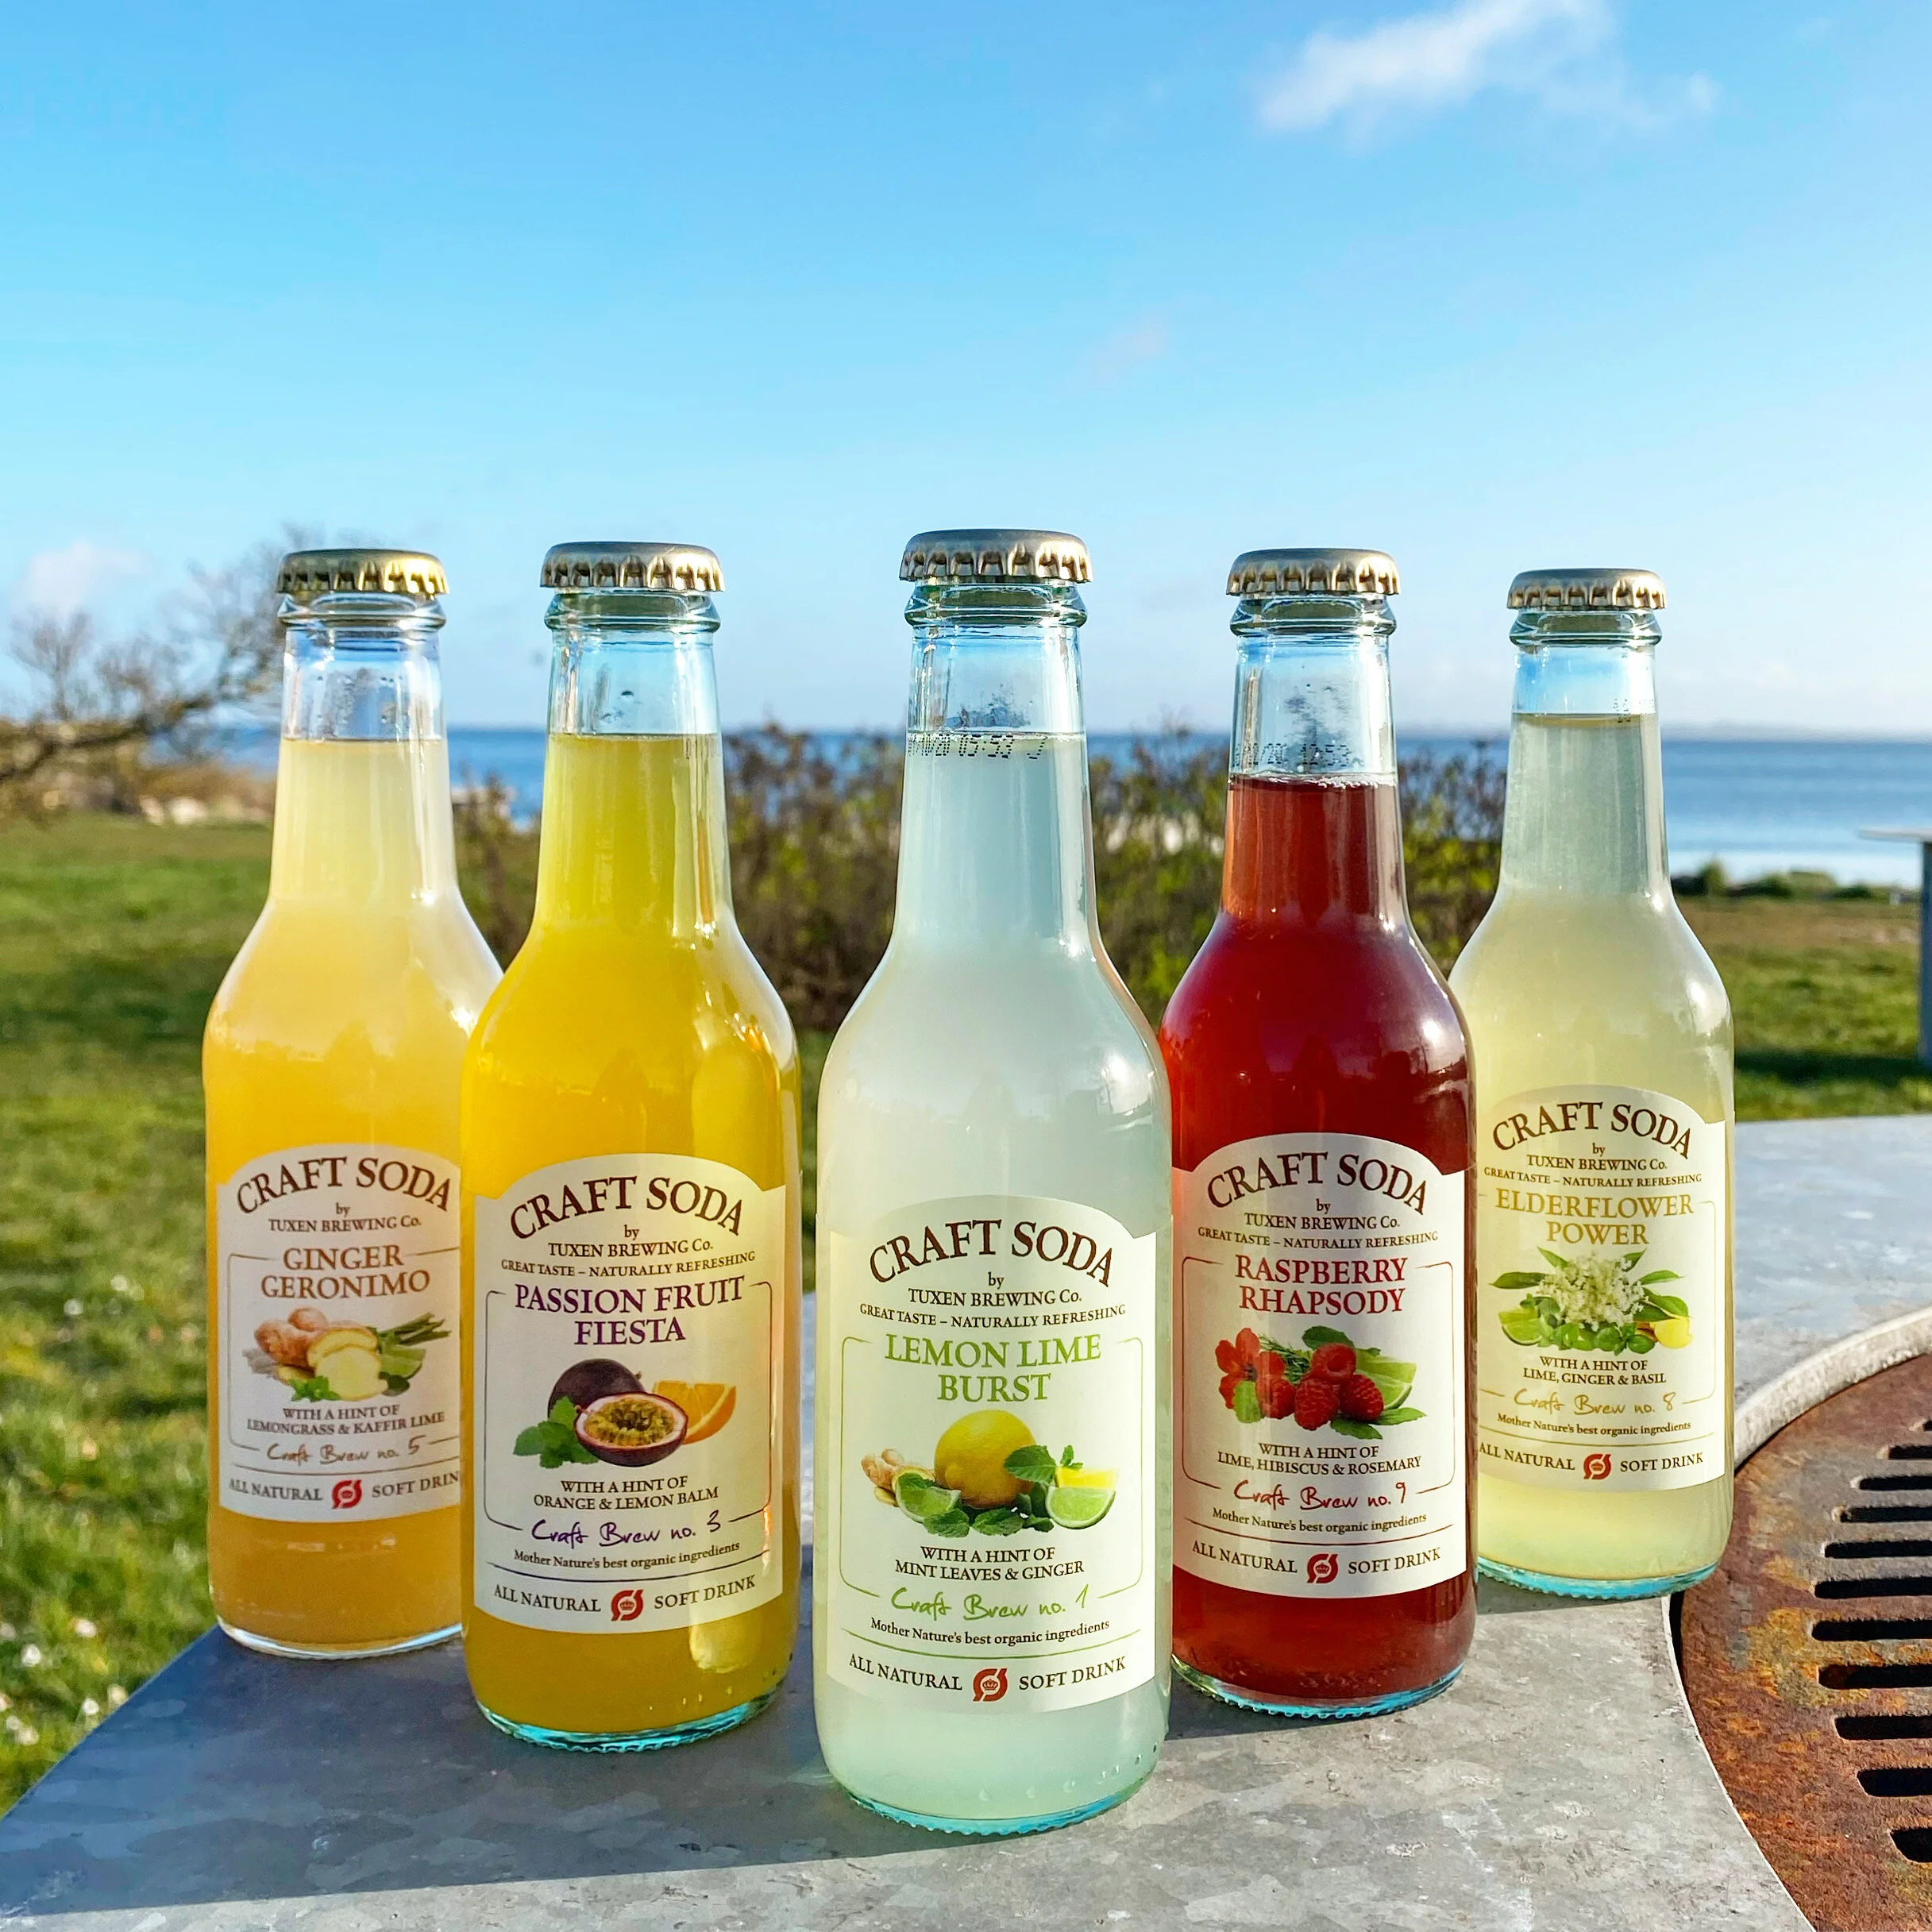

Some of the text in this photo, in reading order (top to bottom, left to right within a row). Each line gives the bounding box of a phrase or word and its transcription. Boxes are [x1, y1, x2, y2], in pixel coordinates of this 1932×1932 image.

[1493, 1101, 1691, 1160] CRAFT SODA
[1526, 1154, 1668, 1170] TUXEN BREWING Co.
[1592, 1142, 1606, 1158] by
[237, 1156, 450, 1214] CRAFT SODA
[1208, 1151, 1426, 1216] CRAFT SODA
[1484, 1167, 1702, 1187] GREAT TASTE NATURALLY REFRESHING
[336, 1202, 350, 1217] by
[511, 1176, 742, 1240] CRAFT SODA
[1316, 1198, 1331, 1215] by
[1495, 1188, 1694, 1219] ELDERFLOWER
[268, 1215, 422, 1232] TUXEN BREWING Co.
[623, 1224, 640, 1241] by
[1244, 1213, 1400, 1230] TUXEN BREWING Co.
[1547, 1221, 1649, 1245] POWER
[548, 1238, 713, 1257] TUXEN BREWING Co.
[1198, 1227, 1438, 1249] GREAT TASTE NATURALLY REFRESHING
[283, 1244, 404, 1271] GINGER
[501, 1251, 755, 1277] GREAT TASTE NATURALLY REFRESHING
[870, 1219, 1113, 1288] CRAFT SODA
[988, 1271, 1005, 1290] by
[1235, 1255, 1408, 1285] RASPBERRY
[261, 1270, 430, 1300] GERONIMO
[515, 1275, 745, 1314] PASSION FRUIT
[908, 1288, 1082, 1307] TUXEN BREWING Co.
[1239, 1286, 1406, 1316] RHAPSODY
[860, 1303, 1125, 1328] GREAT TASTE NATURALLY REFRESHING
[574, 1317, 686, 1345] FIESTA
[885, 1333, 1101, 1368] LEMON LIME
[1539, 1355, 1648, 1371] WITH A HINT OF
[937, 1372, 1051, 1402] BURST
[1523, 1367, 1667, 1385] LIME, GINGER & BASIL
[283, 1405, 399, 1421] WITH A HINT OF
[1514, 1388, 1676, 1416] Craft Brew no. 8
[247, 1412, 445, 1436] LEMONGRASS & KAFFIR LIME
[1498, 1413, 1532, 1428] Mother
[1576, 1424, 1598, 1435] best
[1600, 1426, 1638, 1438] organic
[1641, 1422, 1691, 1436] ingredients
[1217, 1451, 1421, 1475] LIME, HIBISCUS & ROSEMARY
[1259, 1443, 1379, 1459] WITH A HINT OF
[1479, 1442, 1575, 1471] ALL NATURAL
[1620, 1452, 1703, 1472] SOFT DRINK
[561, 1475, 688, 1494] WITH A HINT OF
[1234, 1479, 1406, 1510] Craft Brew no. 9
[534, 1487, 719, 1510] ORANGE & LEMON BALM
[531, 1510, 721, 1549] Craft Brew no. 3
[1213, 1507, 1250, 1525] Mother
[1299, 1519, 1323, 1532] best
[1325, 1522, 1369, 1535] organic
[1371, 1514, 1427, 1533] ingredients
[515, 1549, 552, 1566] Mother
[603, 1556, 628, 1568] best
[631, 1555, 676, 1570] organic
[679, 1542, 740, 1564] ingredients
[920, 1546, 1055, 1563] WITH A HINT OF
[1193, 1541, 1298, 1573] ALL NATURAL
[1348, 1548, 1440, 1575] SOFT DRINK
[895, 1560, 1085, 1581] MINT LEAVES & GINGER
[495, 1584, 601, 1612] ALL NATURAL
[654, 1575, 755, 1610] SOFT DRINK
[891, 1583, 1089, 1621] Craft Brew no. 1
[871, 1617, 910, 1637] Mother
[965, 1631, 992, 1645] best
[994, 1632, 1043, 1647] organic
[1045, 1621, 1110, 1645] ingredients
[850, 1653, 962, 1691] ALL NATURAL
[1019, 1656, 1126, 1691] SOFT DRINK
